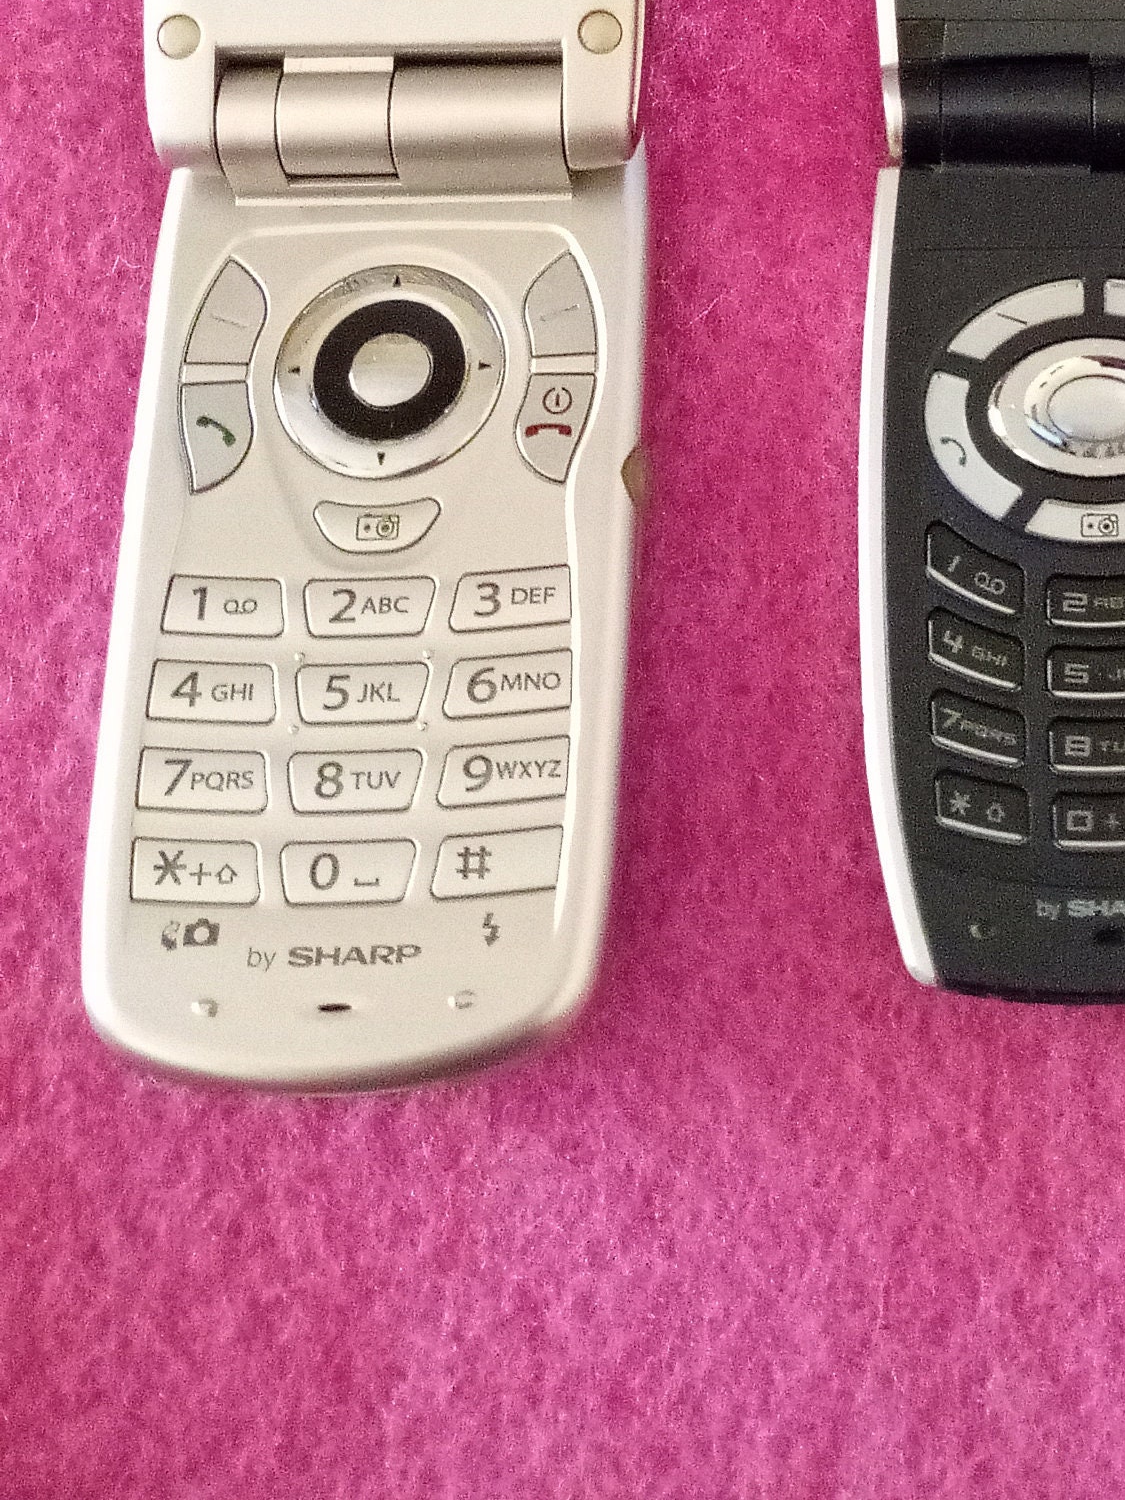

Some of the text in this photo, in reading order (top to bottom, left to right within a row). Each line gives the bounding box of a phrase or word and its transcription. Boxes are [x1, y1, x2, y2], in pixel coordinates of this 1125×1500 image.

[192, 586, 208, 621] 1
[329, 588, 410, 624] 2 ABC
[473, 582, 556, 617] 3 DEF
[170, 671, 254, 707] 4 GHI
[322, 675, 401, 711] 5 JKL
[466, 667, 562, 705] 6 MNO
[164, 759, 254, 796] 7 PQRS
[314, 761, 401, 799] 8 TUV
[463, 755, 562, 792] 9 WXYZ
[309, 852, 339, 890] 0
[246, 944, 422, 971] by SHARP
